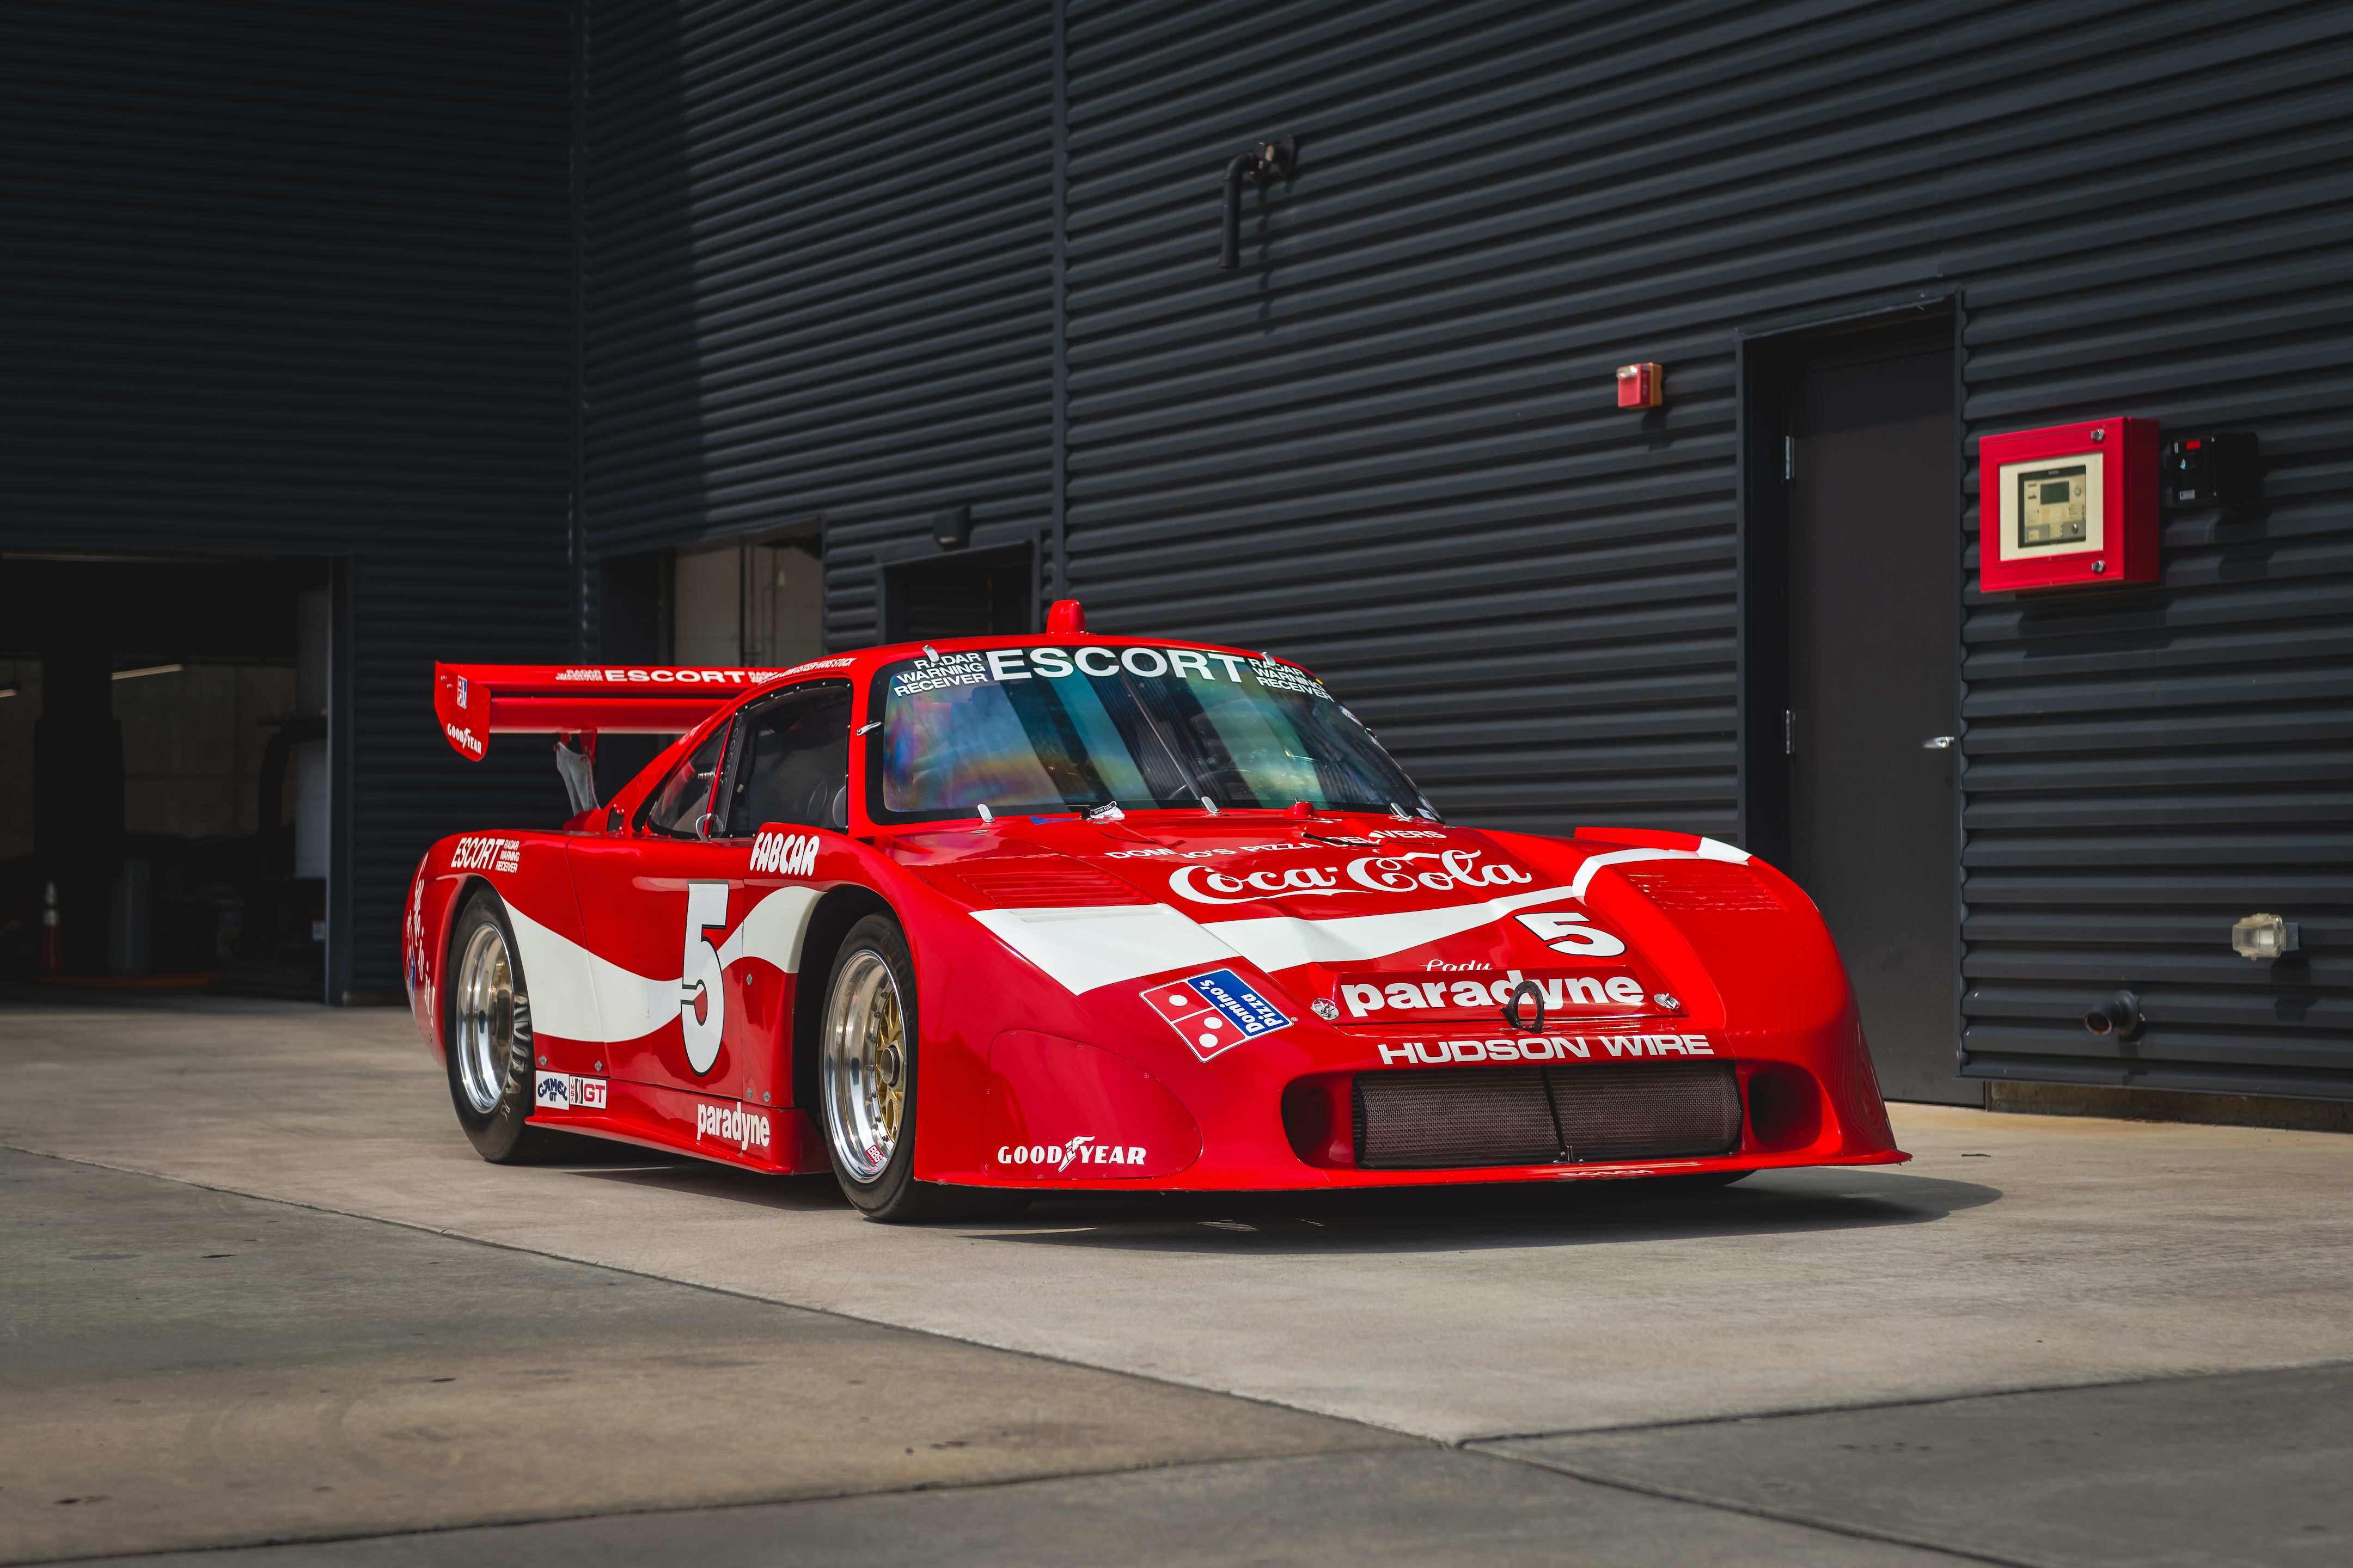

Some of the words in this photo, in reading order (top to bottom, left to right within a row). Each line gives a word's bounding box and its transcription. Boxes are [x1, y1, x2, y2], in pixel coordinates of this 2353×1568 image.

[604, 670, 745, 683] ESCORT
[896, 663, 986, 684] WARNING
[985, 647, 1245, 683] ESCORT
[894, 673, 988, 697] RECEIVER
[1252, 666, 1327, 693] WARNING
[1256, 676, 1335, 702] RECEIVER
[447, 722, 482, 755] GOODYEAR
[450, 837, 505, 870] ESCORT
[500, 850, 520, 862] WARNING
[503, 839, 520, 850] RADAR
[750, 832, 820, 877] FABCAR
[1238, 842, 1323, 852] PIZZA
[495, 861, 518, 873] RECEIVER
[1169, 849, 1532, 904] Coca-Cola
[1513, 911, 1627, 957] 5
[680, 879, 729, 1076] 5
[1199, 979, 1265, 1033] Domino's
[1341, 970, 1645, 1018] paradyne
[1241, 993, 1284, 1027] Pizza
[1377, 1037, 1591, 1065] HUDSON
[1598, 1034, 1715, 1057] WIRE
[537, 1077, 568, 1101] CAMEL
[584, 1083, 606, 1103] GT
[696, 1101, 771, 1150] paradyne
[866, 1145, 883, 1163] BBS
[998, 1143, 1146, 1167] GOODYEAR
